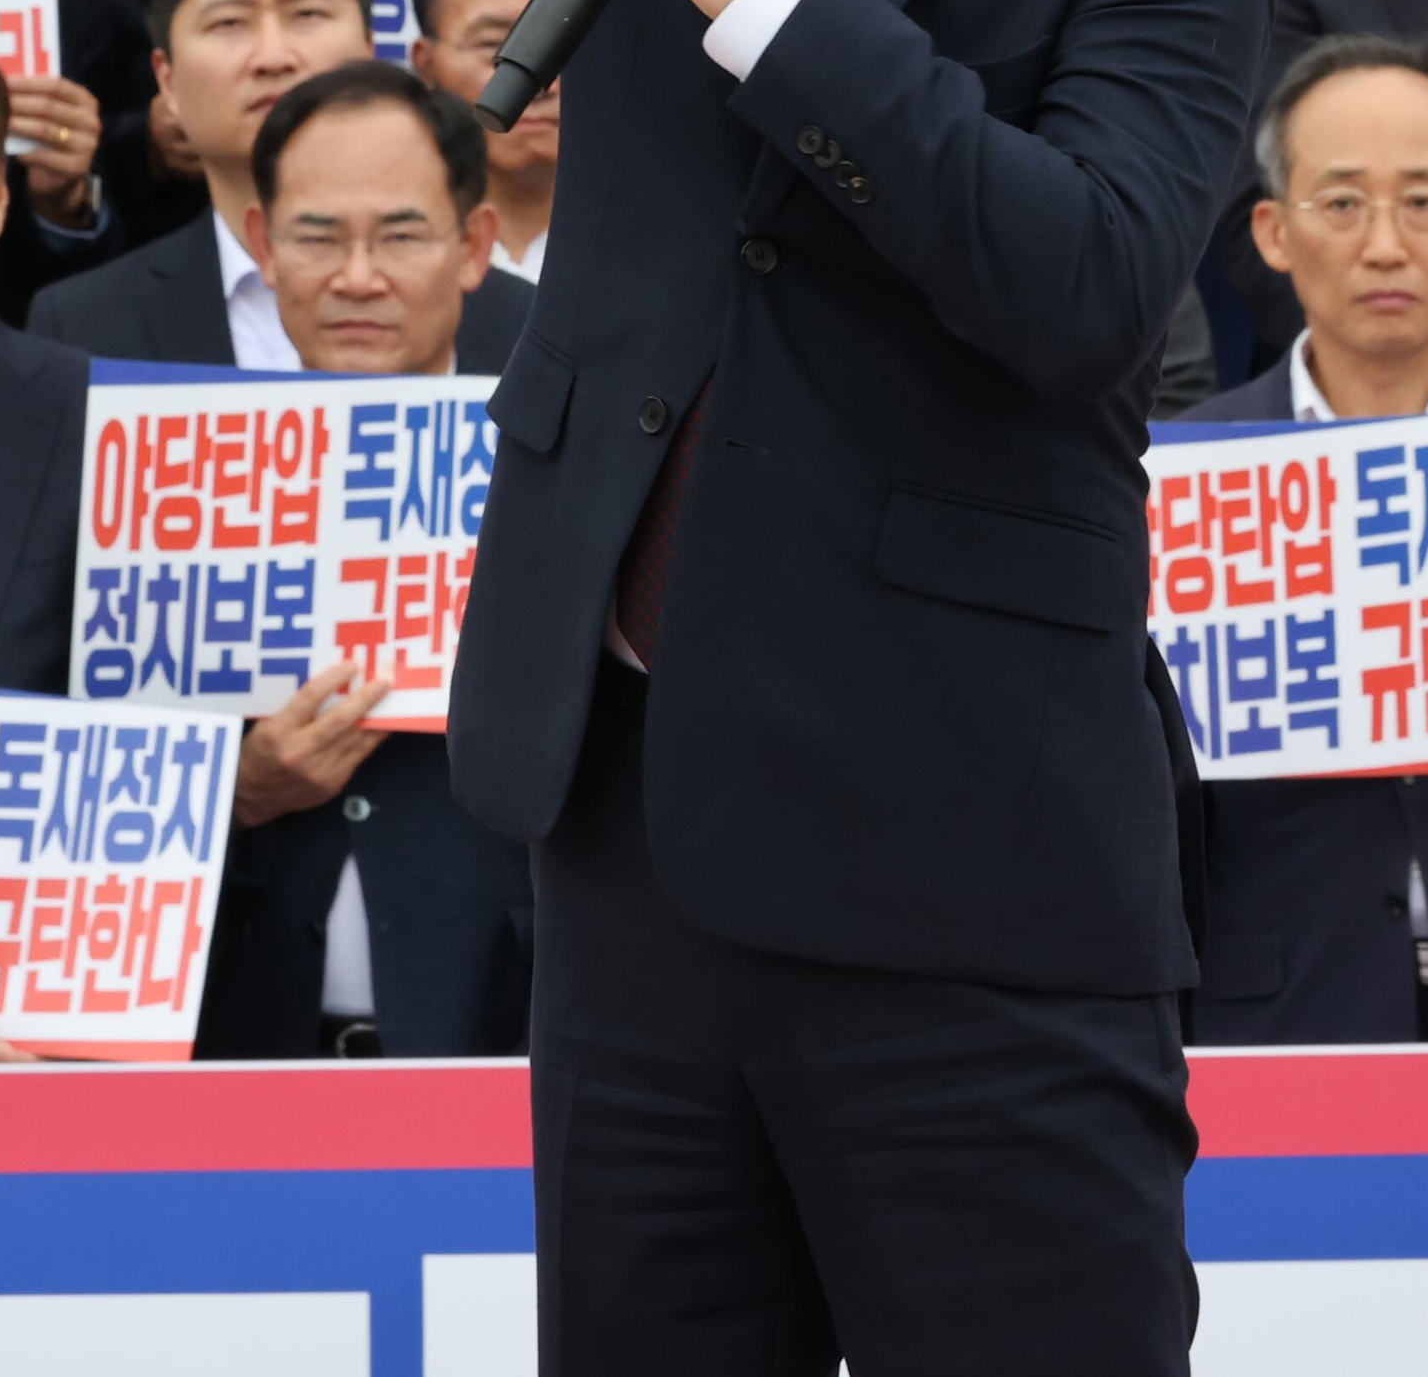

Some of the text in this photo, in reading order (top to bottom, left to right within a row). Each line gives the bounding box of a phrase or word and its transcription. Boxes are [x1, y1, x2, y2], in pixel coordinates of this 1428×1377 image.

[92, 405, 329, 552] 야당탄압
[83, 546, 478, 701] 정치보복 규탄
